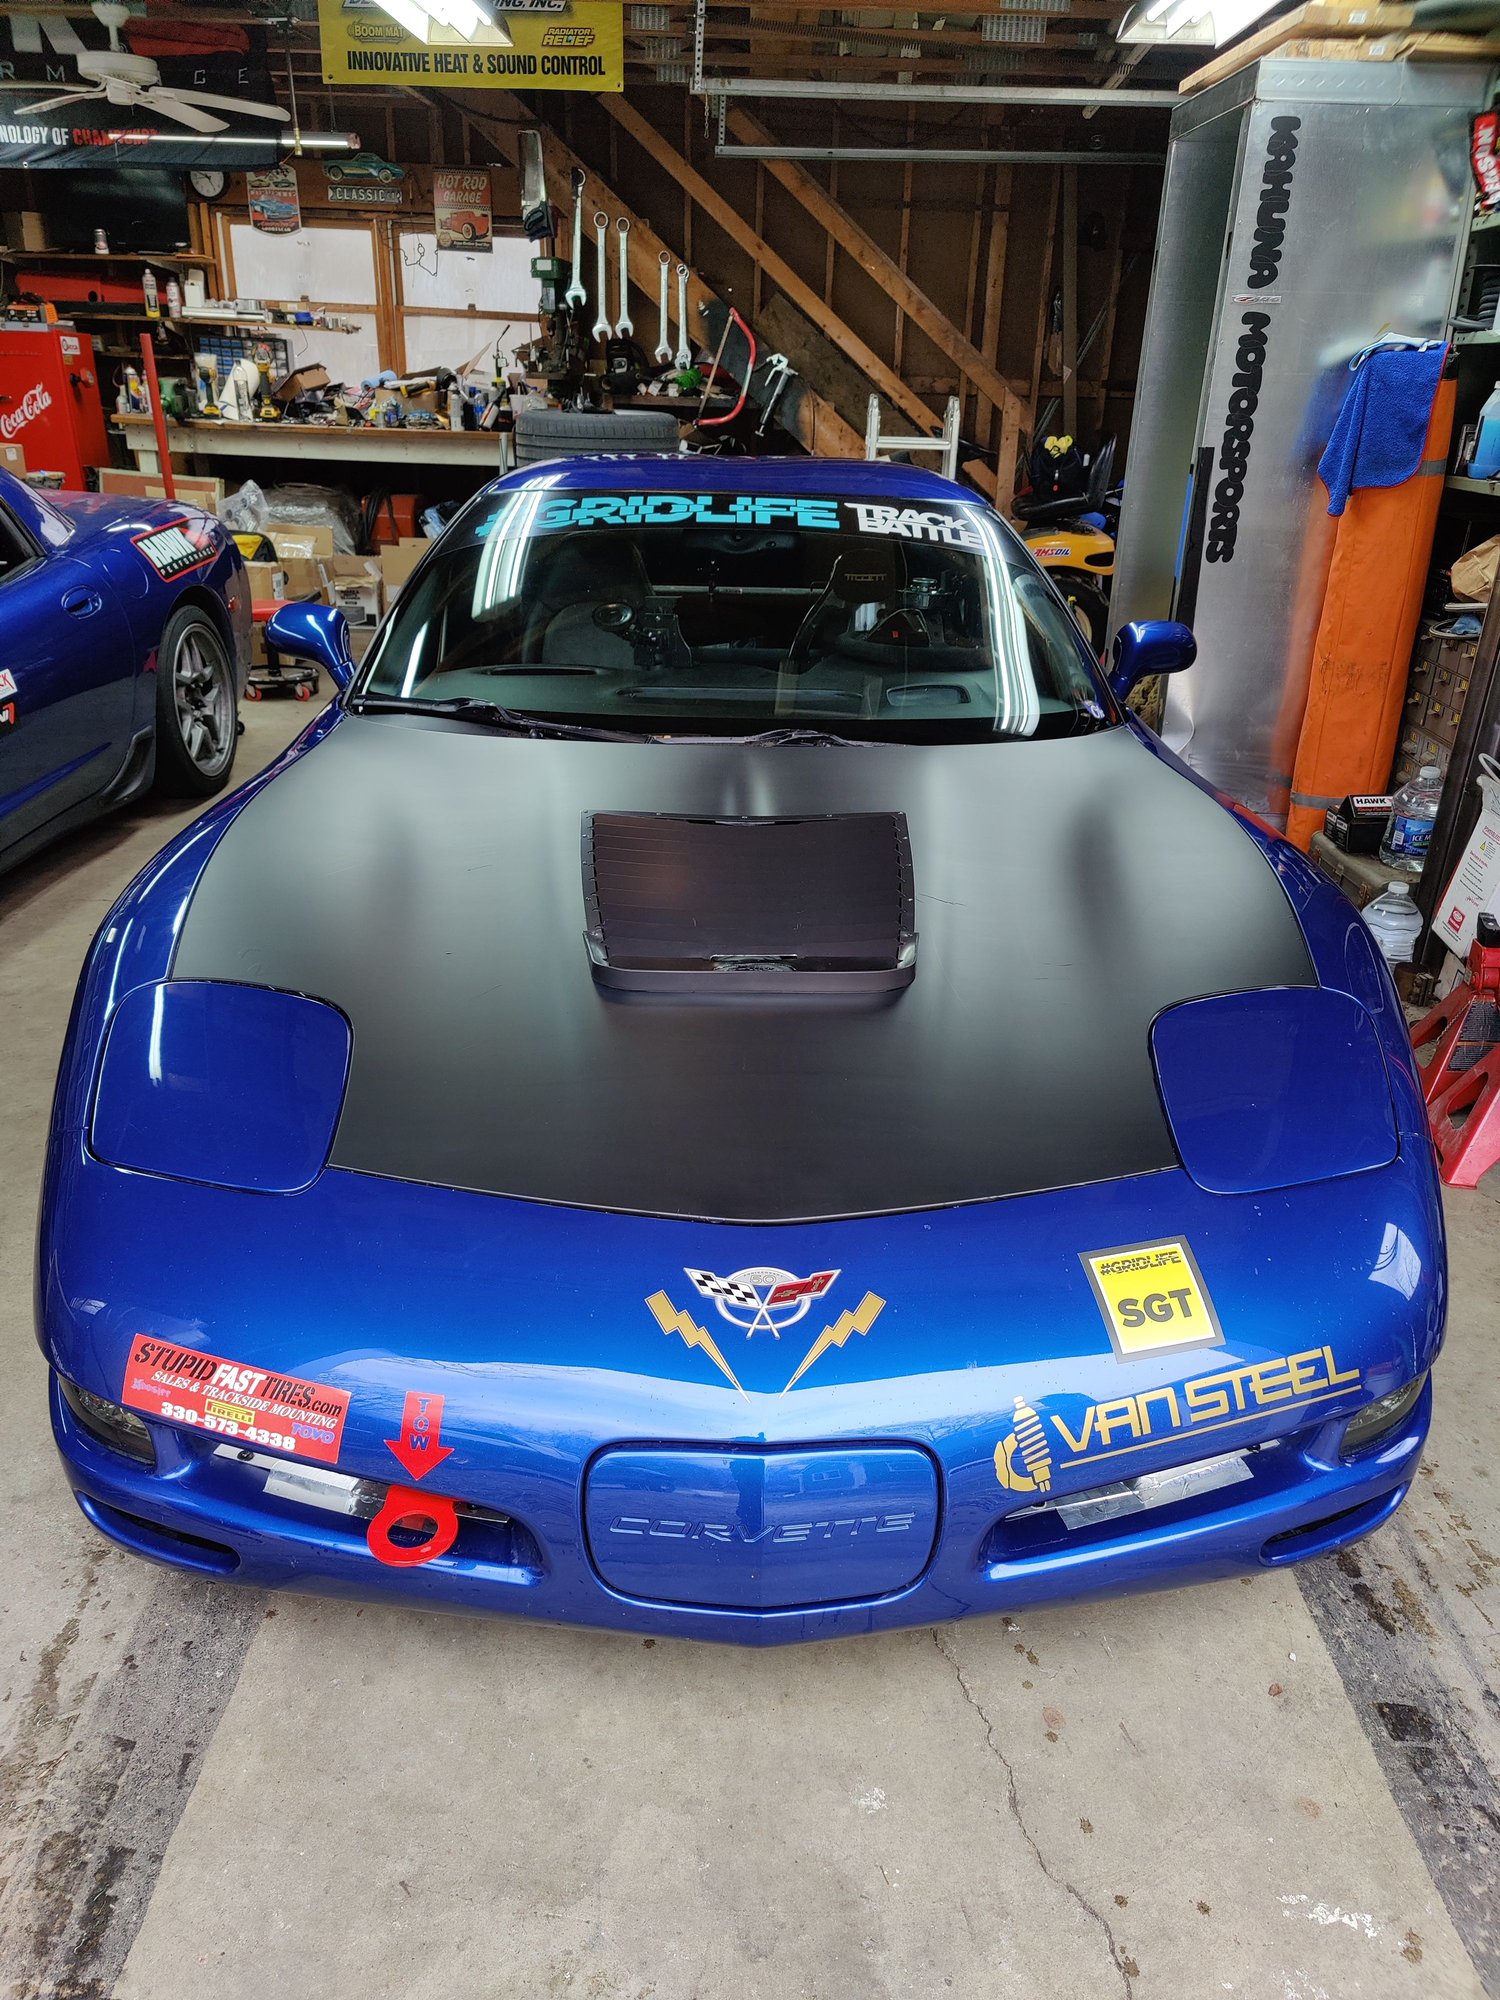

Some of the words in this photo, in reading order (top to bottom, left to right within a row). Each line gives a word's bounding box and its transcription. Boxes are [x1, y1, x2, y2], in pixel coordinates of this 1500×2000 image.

[354, 25, 383, 37] BOOM
[386, 26, 404, 37] MAT
[542, 35, 595, 46] RELIEF
[548, 28, 591, 36] RADIATOR
[347, 51, 431, 73] INNOVATIVE
[434, 53, 469, 74] HEAT
[472, 55, 484, 74] &
[487, 55, 538, 75] SOUND
[541, 55, 606, 76] CONTROL
[51, 127, 69, 146] OF
[336, 187, 385, 201] CLASSIC
[438, 175, 460, 189] HOT
[463, 176, 487, 191] ROD
[443, 190, 482, 204] GARAGE
[1247, 115, 1301, 289] KAHUNA
[0, 381, 53, 439] Coca-Cola
[1205, 311, 1271, 563] MOTORSPORTS
[844, 502, 969, 531] TRACK
[858, 517, 985, 549] BATTLE
[1034, 547, 1072, 557] AMSOIL
[1412, 834, 1424, 842] ICE
[1100, 1251, 1182, 1276] #GRIDLIFE
[750, 1274, 777, 1284] 50
[1117, 1287, 1193, 1328] SGT
[130, 1377, 172, 1398] Hoosier
[151, 1370, 191, 1390] SALES
[189, 1381, 200, 1393] &
[200, 1384, 271, 1412] TRACKSIDE
[268, 1403, 339, 1430] MOUNTING
[206, 1400, 254, 1424] PIRELLI
[160, 1401, 297, 1451] 330-573-4338
[409, 1397, 431, 1451] TOW
[608, 1511, 917, 1544] CORVETTE
